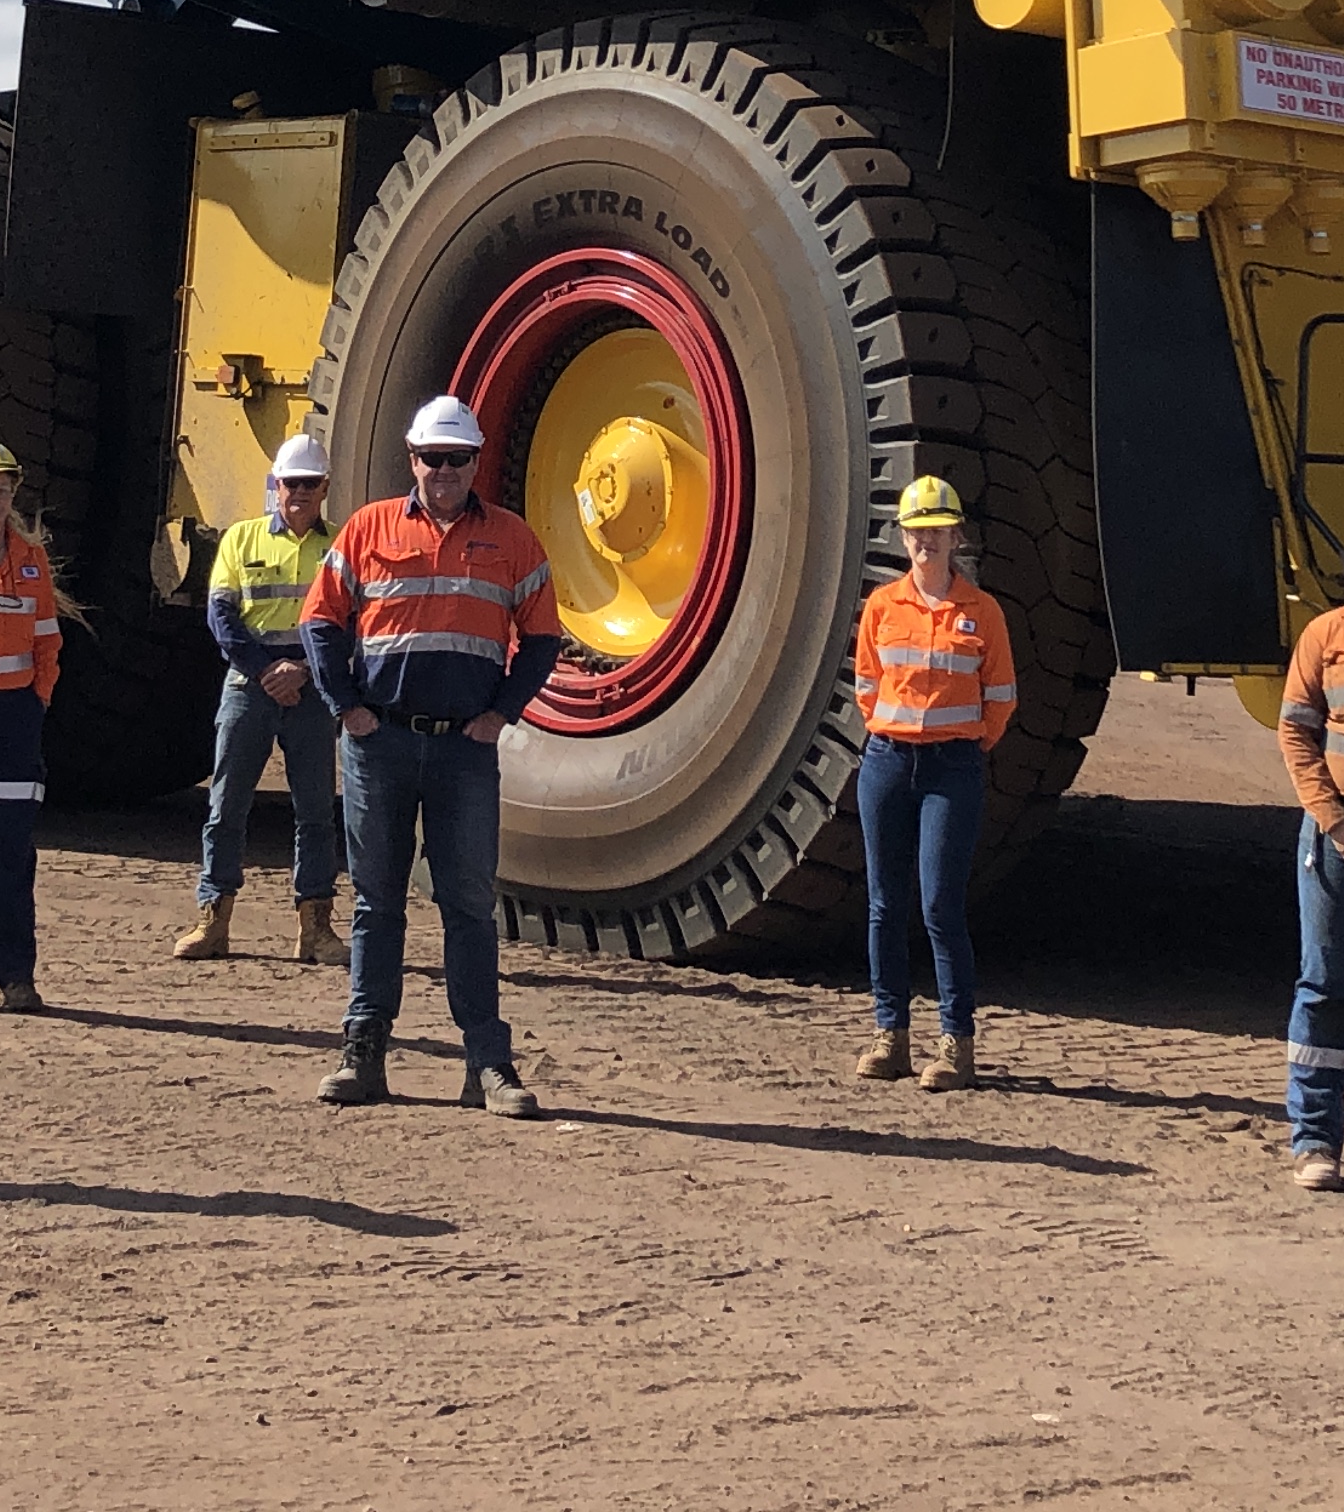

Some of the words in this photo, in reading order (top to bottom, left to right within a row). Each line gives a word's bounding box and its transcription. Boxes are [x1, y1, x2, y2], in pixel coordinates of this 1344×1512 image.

[1246, 45, 1267, 64] NO
[1256, 68, 1323, 95] PARKING
[1276, 92, 1297, 111] 50
[532, 188, 643, 228] EXTRA
[654, 210, 730, 299] LOAD
